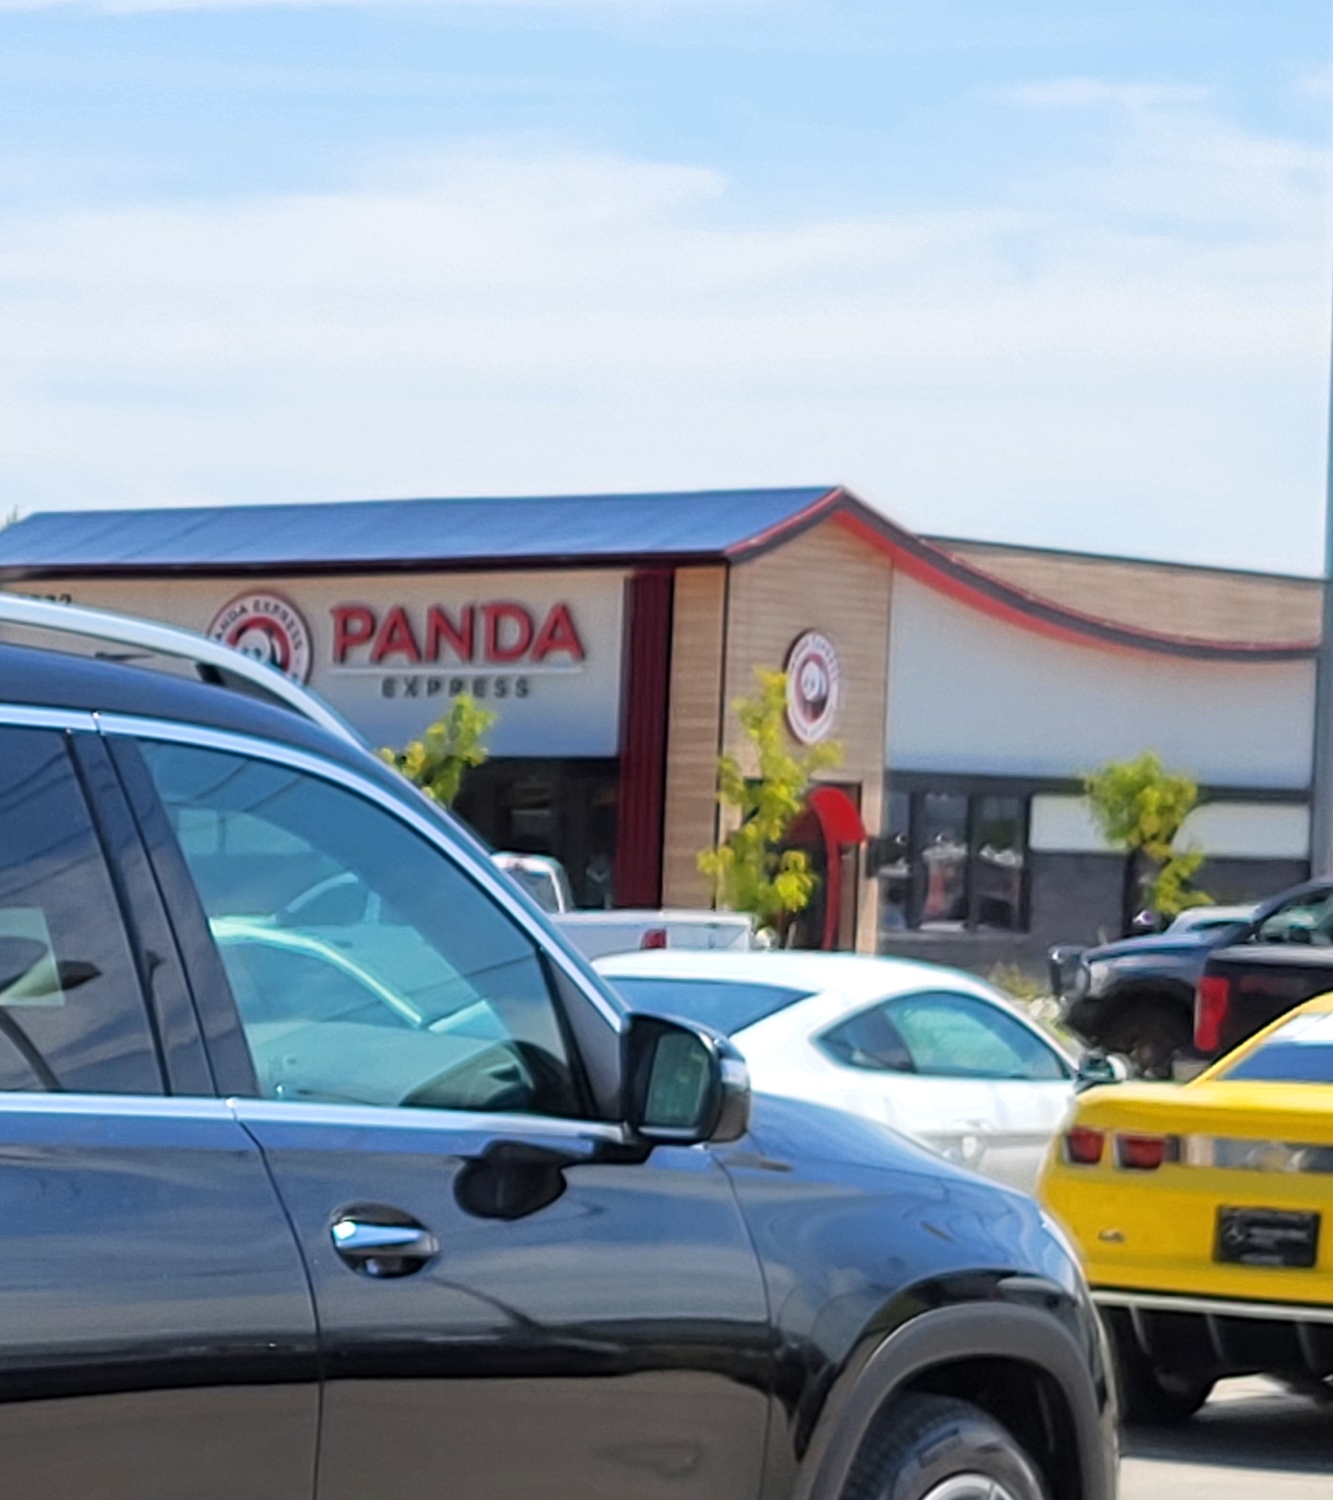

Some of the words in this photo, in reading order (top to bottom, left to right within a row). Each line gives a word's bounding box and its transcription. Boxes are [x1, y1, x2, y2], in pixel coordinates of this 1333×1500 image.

[215, 603, 249, 642] ANDA
[252, 599, 303, 651] EXPRESS
[330, 601, 586, 664] PANDA
[381, 677, 531, 698] EXPRESS
